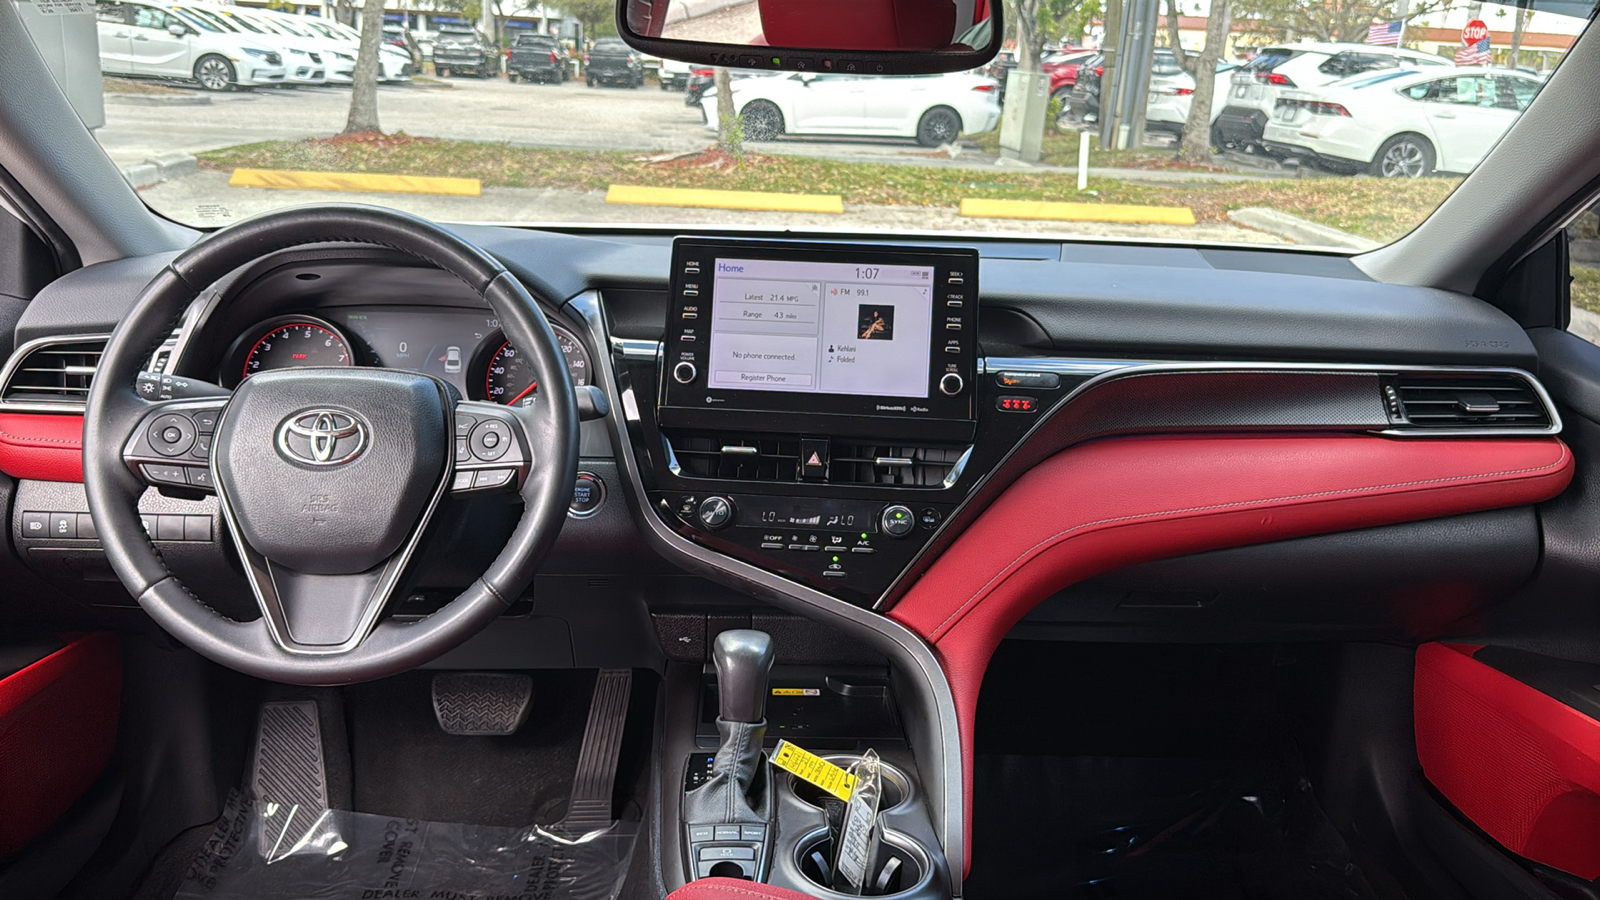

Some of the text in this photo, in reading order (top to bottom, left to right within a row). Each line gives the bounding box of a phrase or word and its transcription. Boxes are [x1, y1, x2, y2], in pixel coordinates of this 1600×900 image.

[1464, 27, 1487, 38] STOP
[718, 263, 744, 272] Home
[856, 268, 879, 279] 1:07
[743, 310, 762, 319] Range
[400, 342, 407, 352] 0
[741, 374, 765, 382] Register
[362, 889, 420, 899] DEALER
